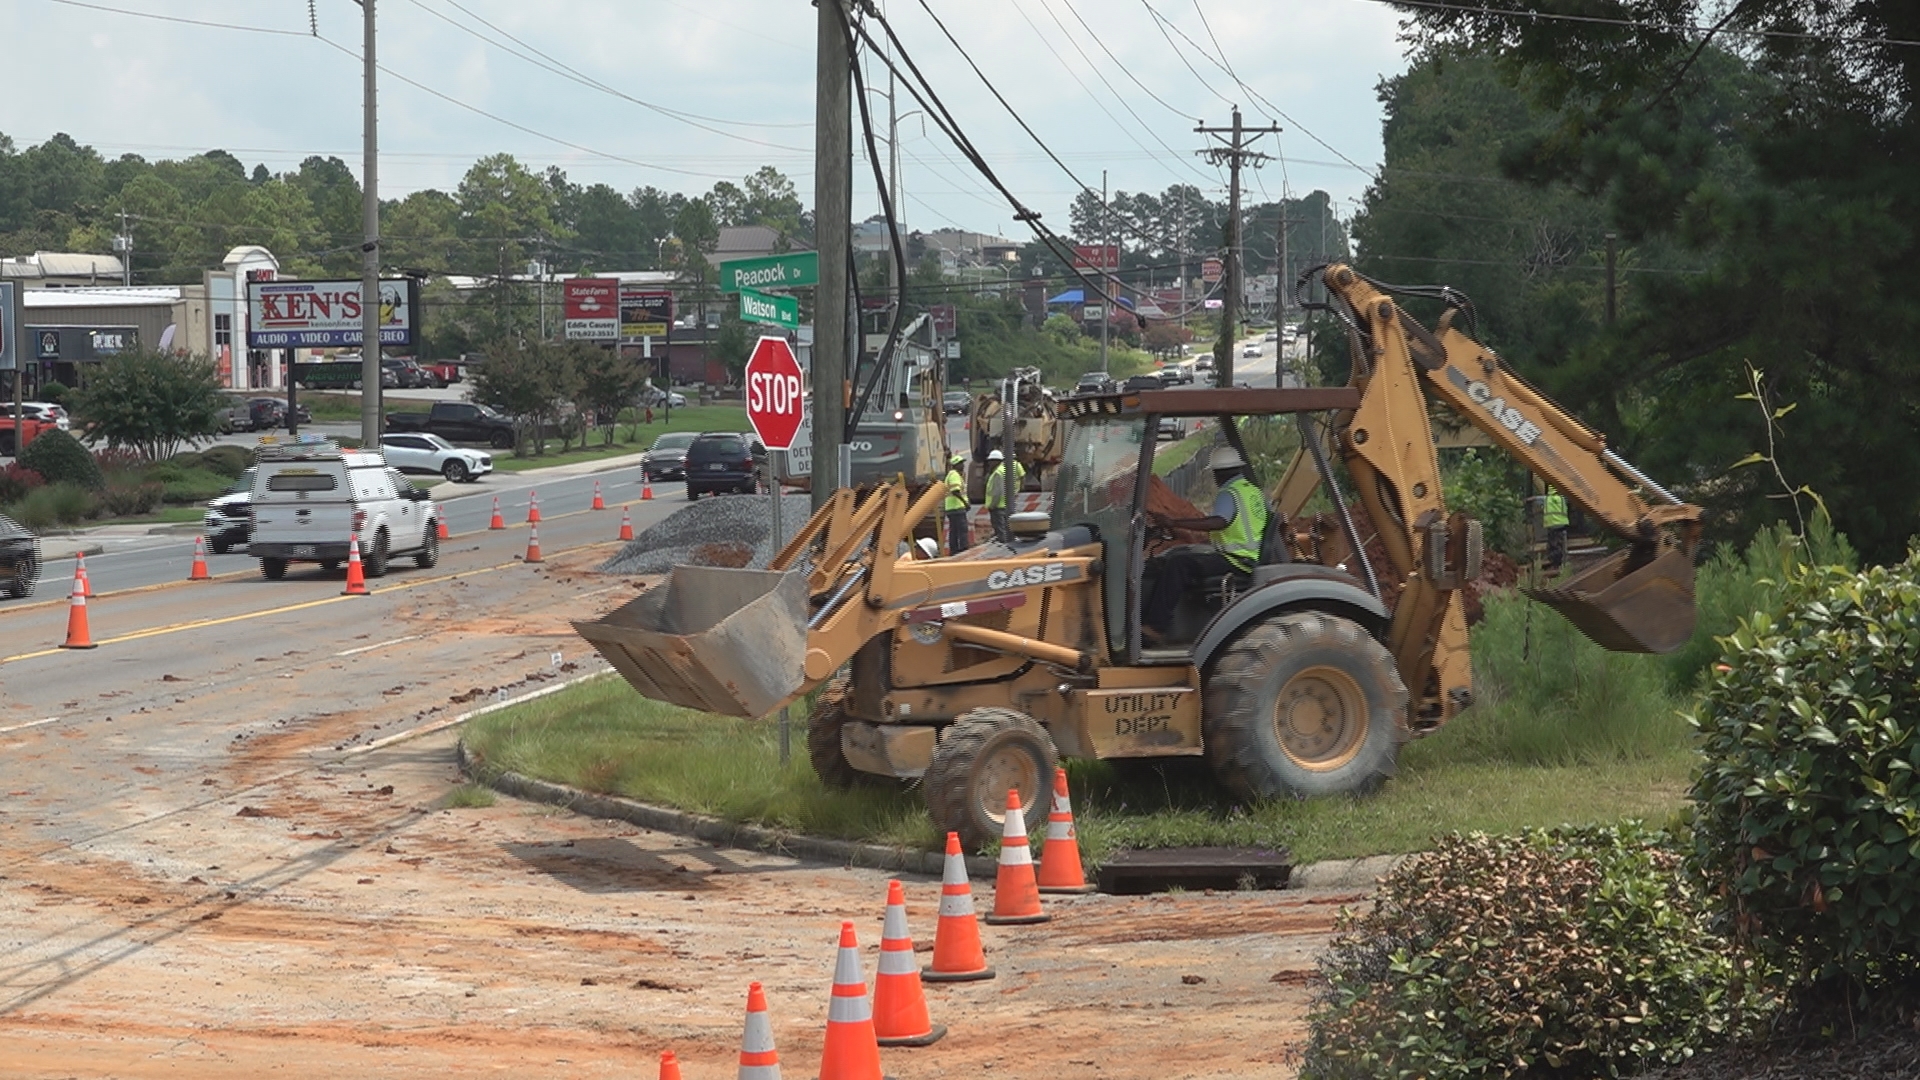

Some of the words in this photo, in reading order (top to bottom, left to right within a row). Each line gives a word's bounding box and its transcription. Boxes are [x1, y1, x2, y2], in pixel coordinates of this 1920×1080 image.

[734, 262, 786, 287] Peacock
[793, 268, 801, 278] Dr
[260, 291, 361, 320] KEN'S
[743, 296, 776, 318] Watson
[781, 310, 791, 322] Blvd
[310, 320, 362, 329] kensonline.co
[567, 321, 587, 329] Eddie
[588, 321, 616, 329] Causey
[256, 332, 288, 345] AUDIO
[300, 331, 330, 343] VIDEO
[343, 330, 363, 342] CAR
[379, 330, 405, 342] EREO
[750, 371, 800, 415] STOP
[1466, 380, 1542, 445] CASE
[986, 562, 1064, 591] CASE
[1104, 692, 1182, 714] UTILITY
[1115, 715, 1170, 736] DEPT
